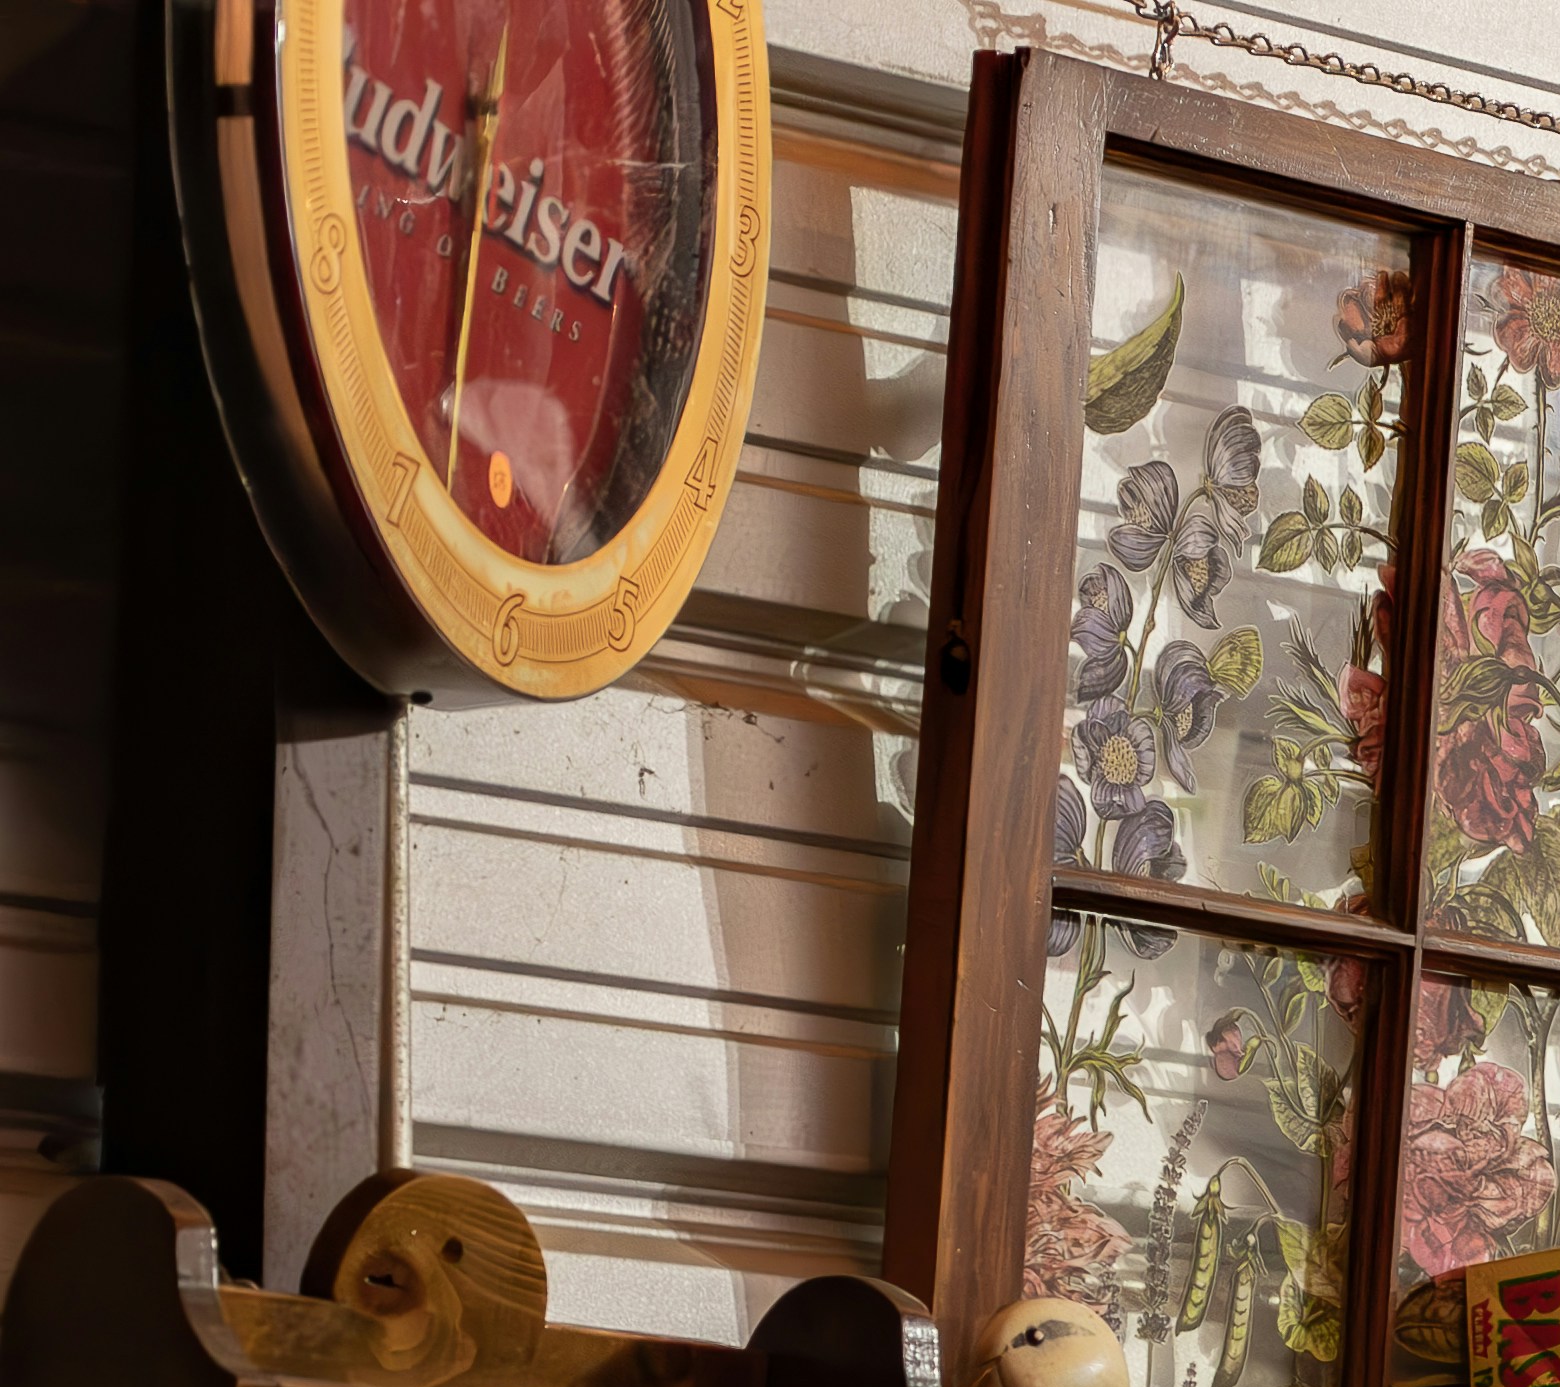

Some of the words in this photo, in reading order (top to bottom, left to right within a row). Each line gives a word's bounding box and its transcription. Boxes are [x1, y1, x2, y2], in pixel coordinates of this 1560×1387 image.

[343, 45, 629, 302] udweiser
[308, 212, 348, 296] 8
[491, 266, 583, 345] BEERS
[384, 450, 421, 529] 7
[683, 435, 719, 513] 4
[491, 592, 526, 668] 6
[605, 574, 641, 652] 5
